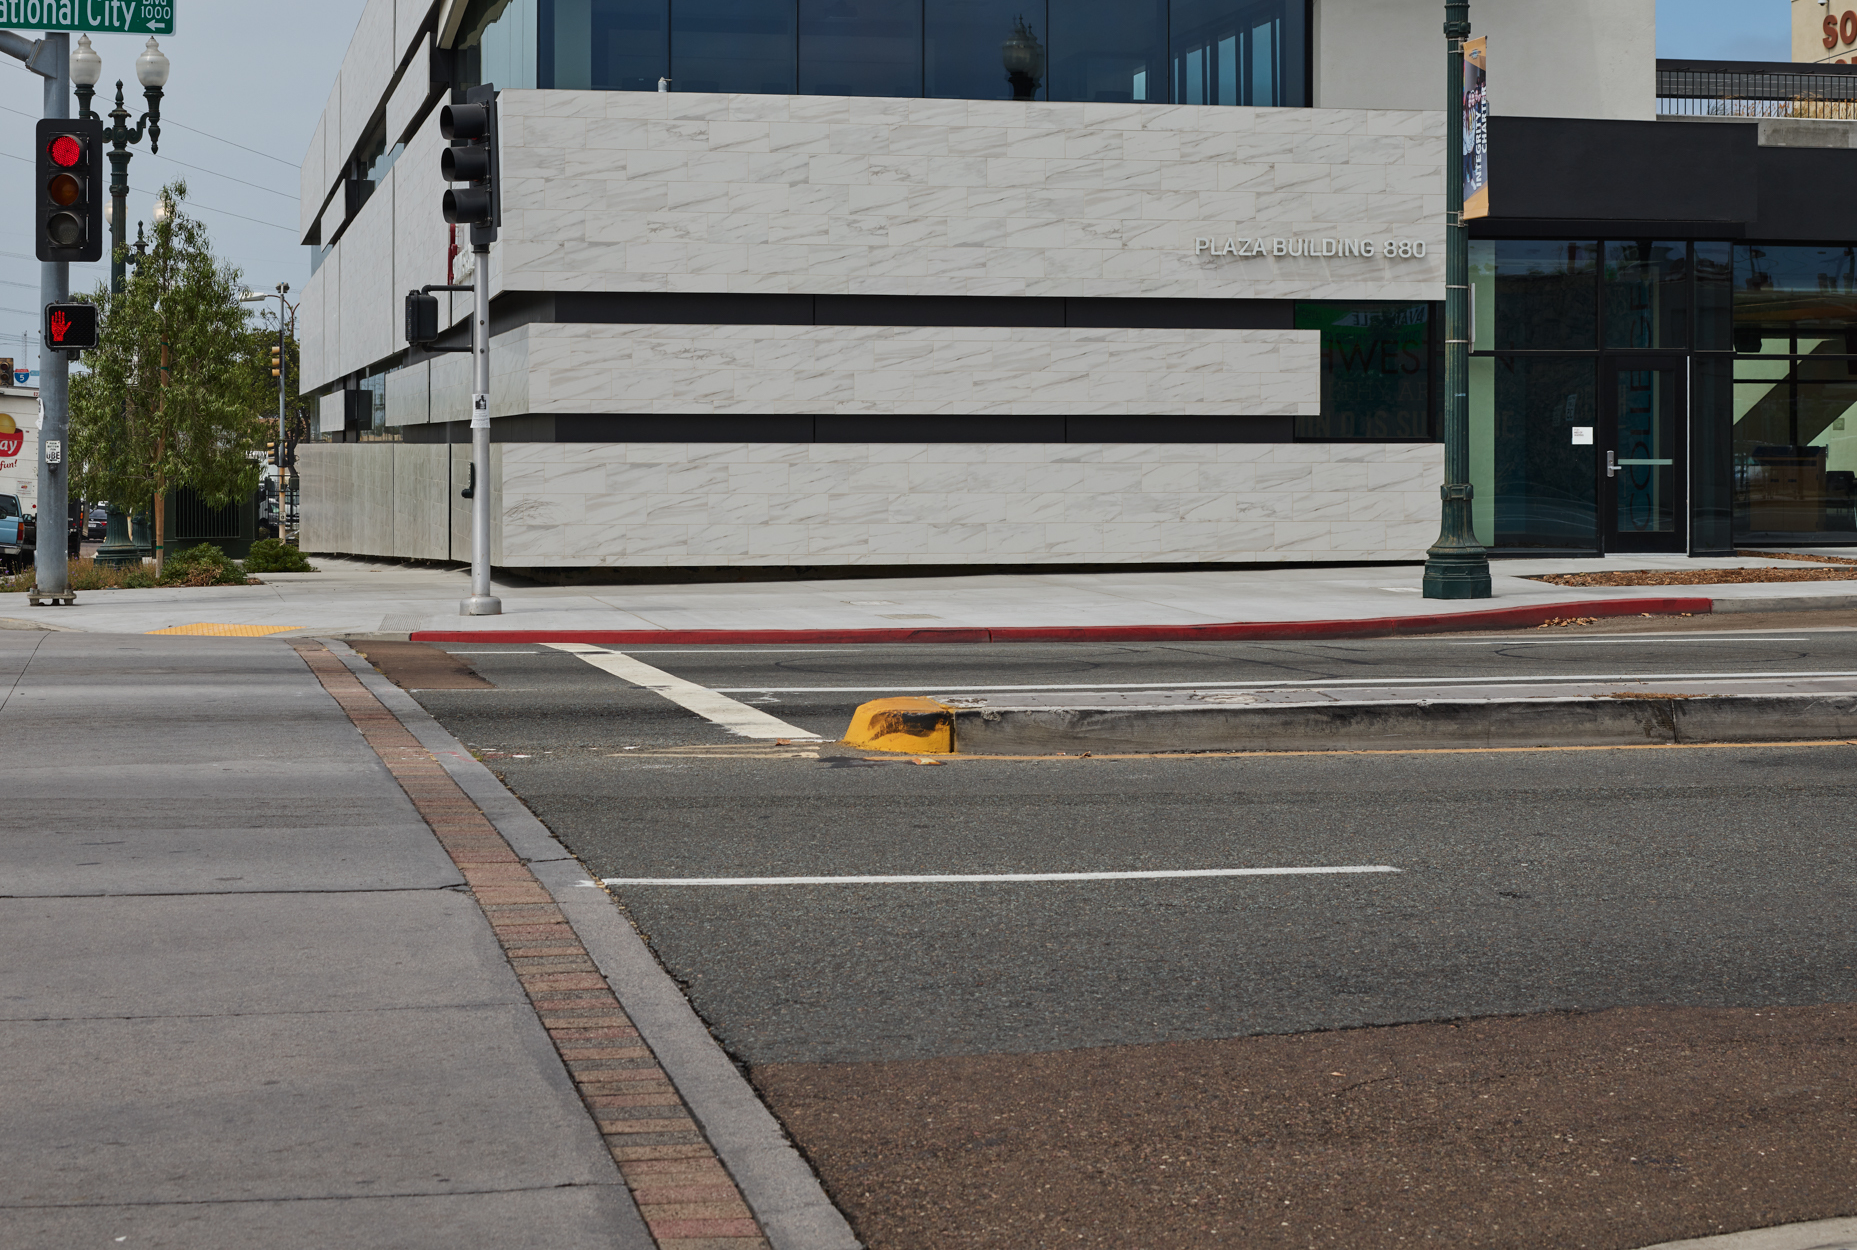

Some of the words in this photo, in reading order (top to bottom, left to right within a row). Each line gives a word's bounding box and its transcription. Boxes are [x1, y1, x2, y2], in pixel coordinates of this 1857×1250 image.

[141, 6, 171, 19] 1000
[1822, 10, 1857, 49] SO
[1194, 237, 1267, 257] PLAZA
[1273, 237, 1375, 258] BUILDING
[1383, 239, 1427, 259] 880
[19, 374, 25, 382] 5
